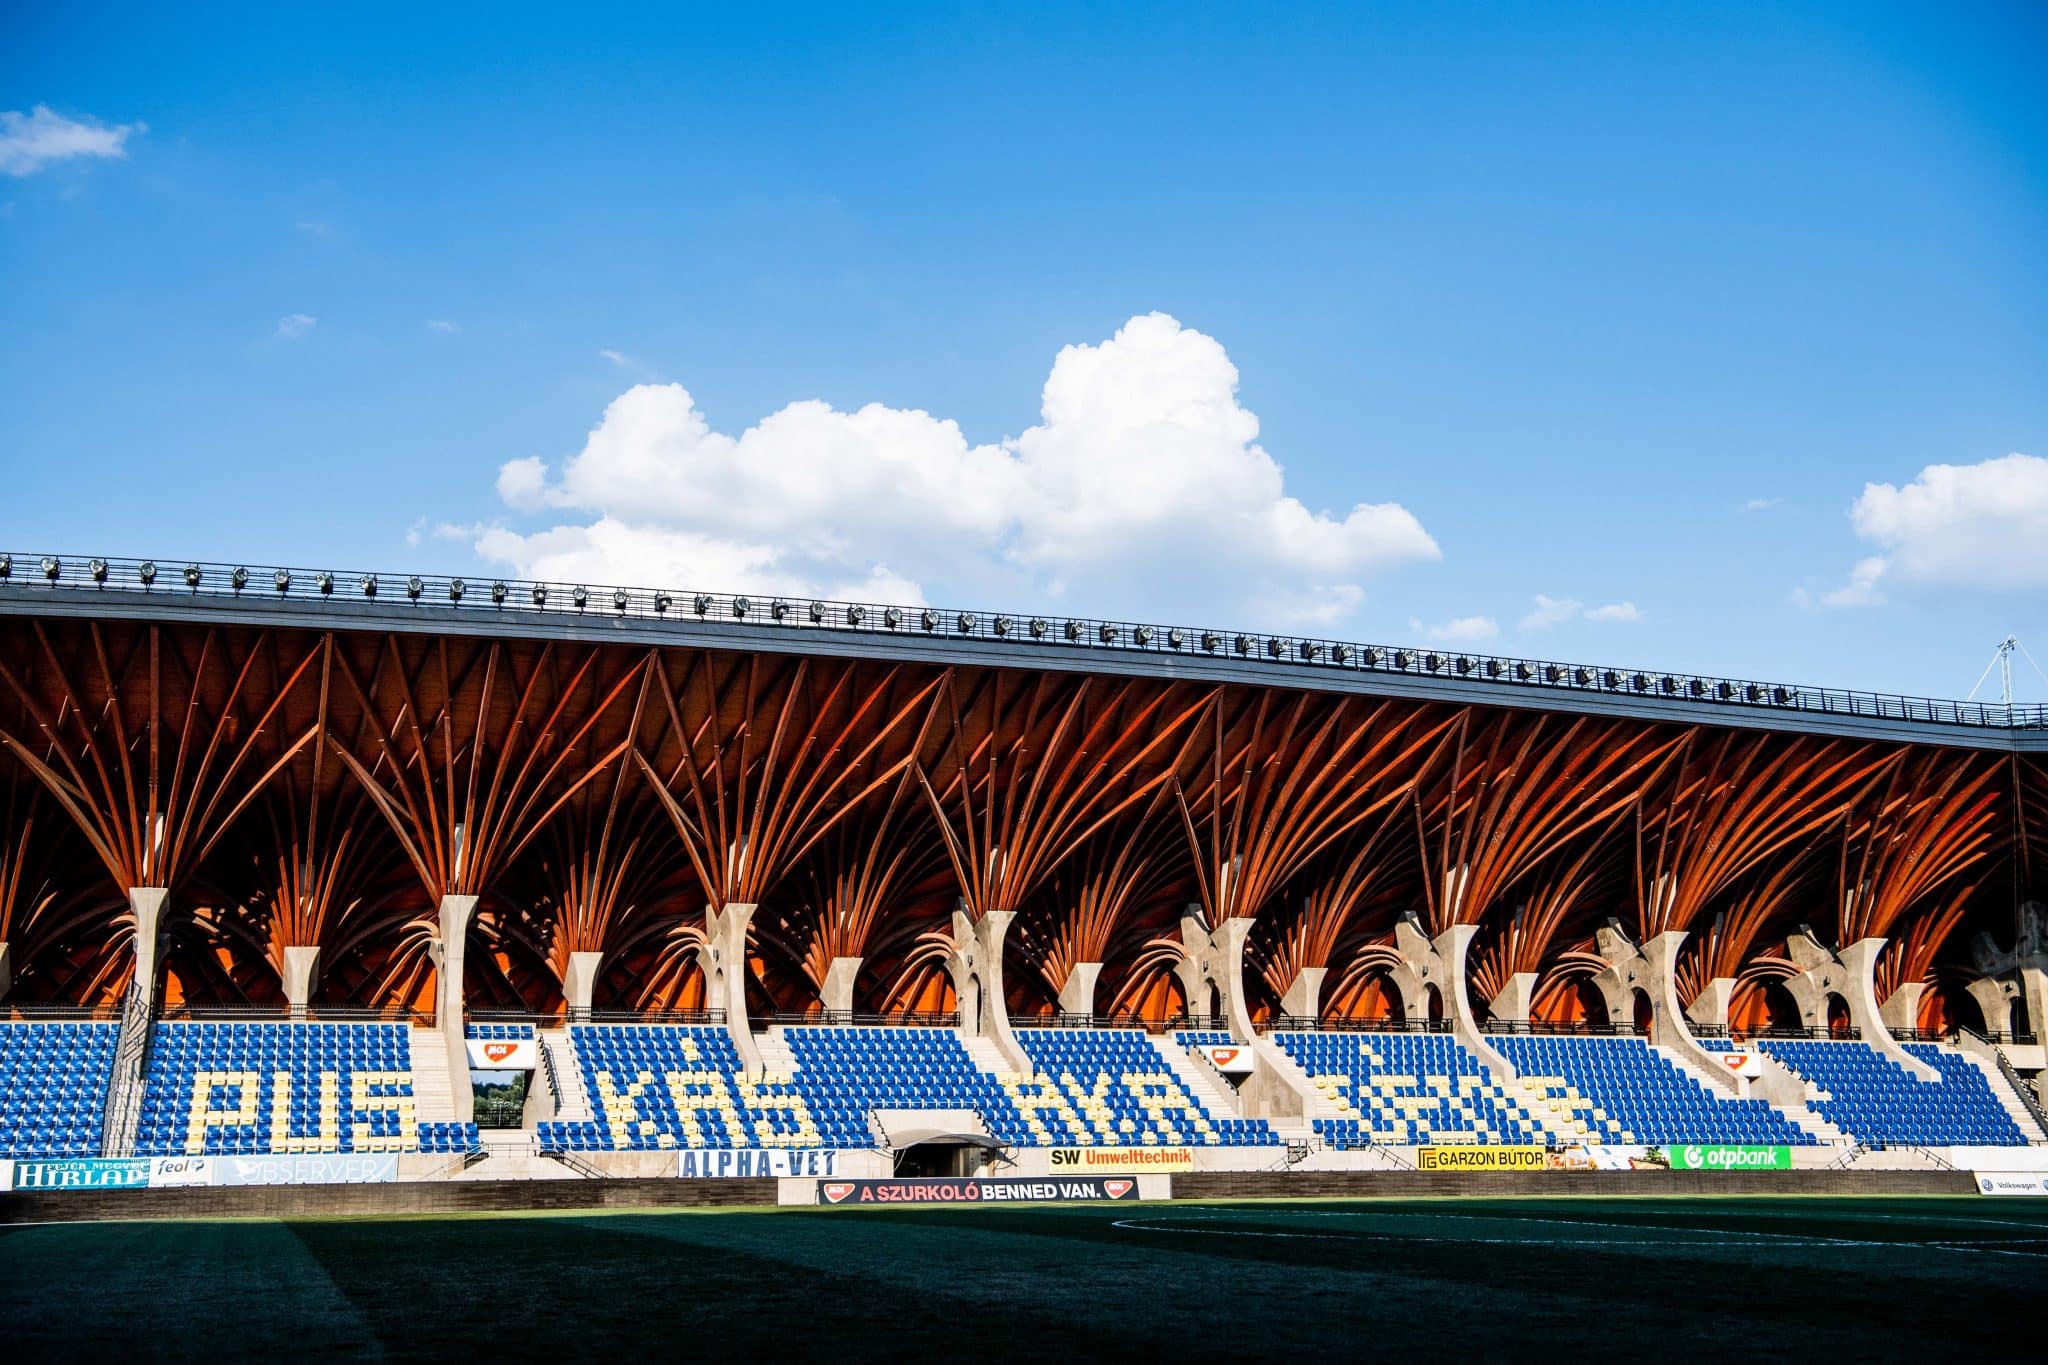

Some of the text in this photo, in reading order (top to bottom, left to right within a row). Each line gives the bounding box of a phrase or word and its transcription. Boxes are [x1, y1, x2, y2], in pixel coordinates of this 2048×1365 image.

[682, 1150, 836, 1177] ALPHA-VET
[1051, 1148, 1192, 1164] SW Umwelttechnik
[1438, 1148, 1544, 1165] GARZON BÚTOR
[1707, 1145, 1778, 1169] otpbank
[158, 1159, 190, 1175] feol
[860, 1181, 1101, 1201] A SZURKOLÓ BENNED VAN.
[1997, 1182, 2037, 1190] Volkswagen
